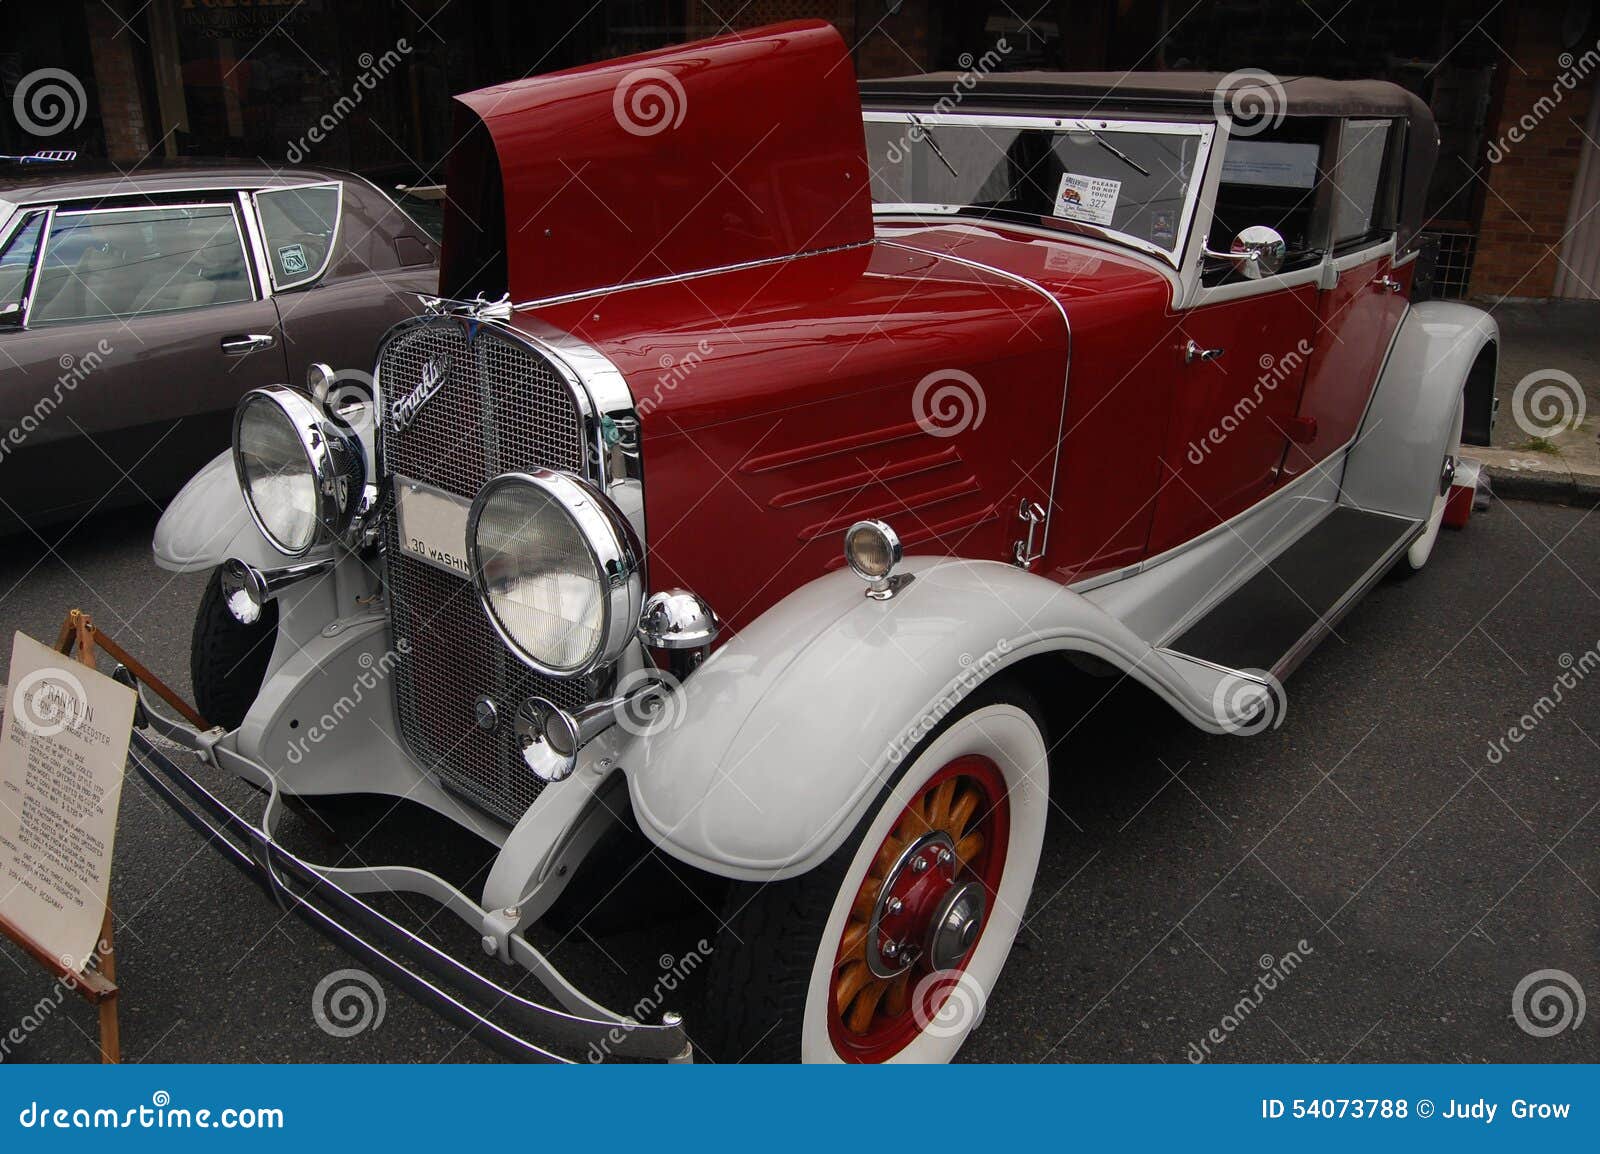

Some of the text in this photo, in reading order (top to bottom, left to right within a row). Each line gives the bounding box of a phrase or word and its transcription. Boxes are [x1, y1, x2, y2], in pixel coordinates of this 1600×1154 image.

[1089, 199, 1106, 209] 327
[1091, 191, 1114, 199] TOUCH
[392, 351, 451, 431] Franklin
[39, 680, 93, 723] FRANKLIN
[77, 720, 110, 746] SPEEDSTER
[80, 839, 103, 858] SPEEDSTER
